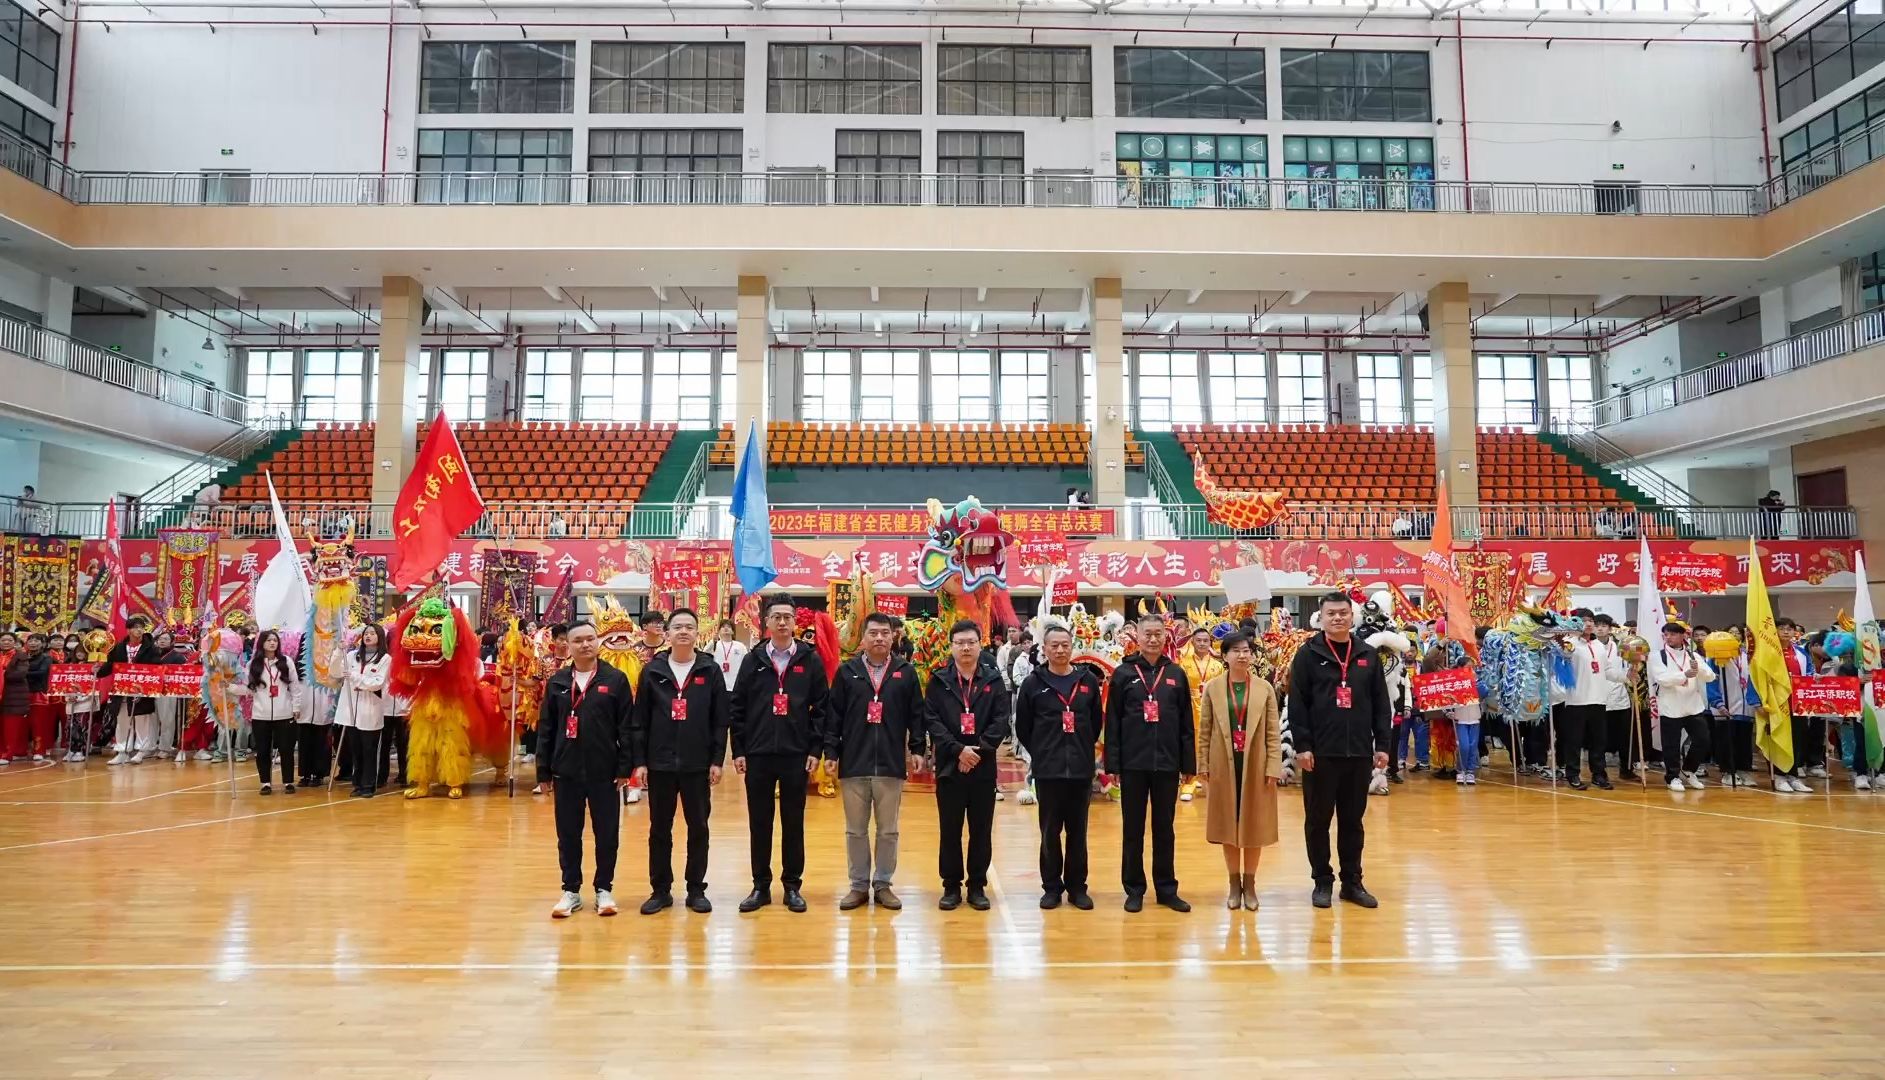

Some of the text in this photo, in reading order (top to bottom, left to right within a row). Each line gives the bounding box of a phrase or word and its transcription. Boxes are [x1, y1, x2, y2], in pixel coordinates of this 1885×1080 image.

[1661, 566, 1722, 578] 泉州师范学院
